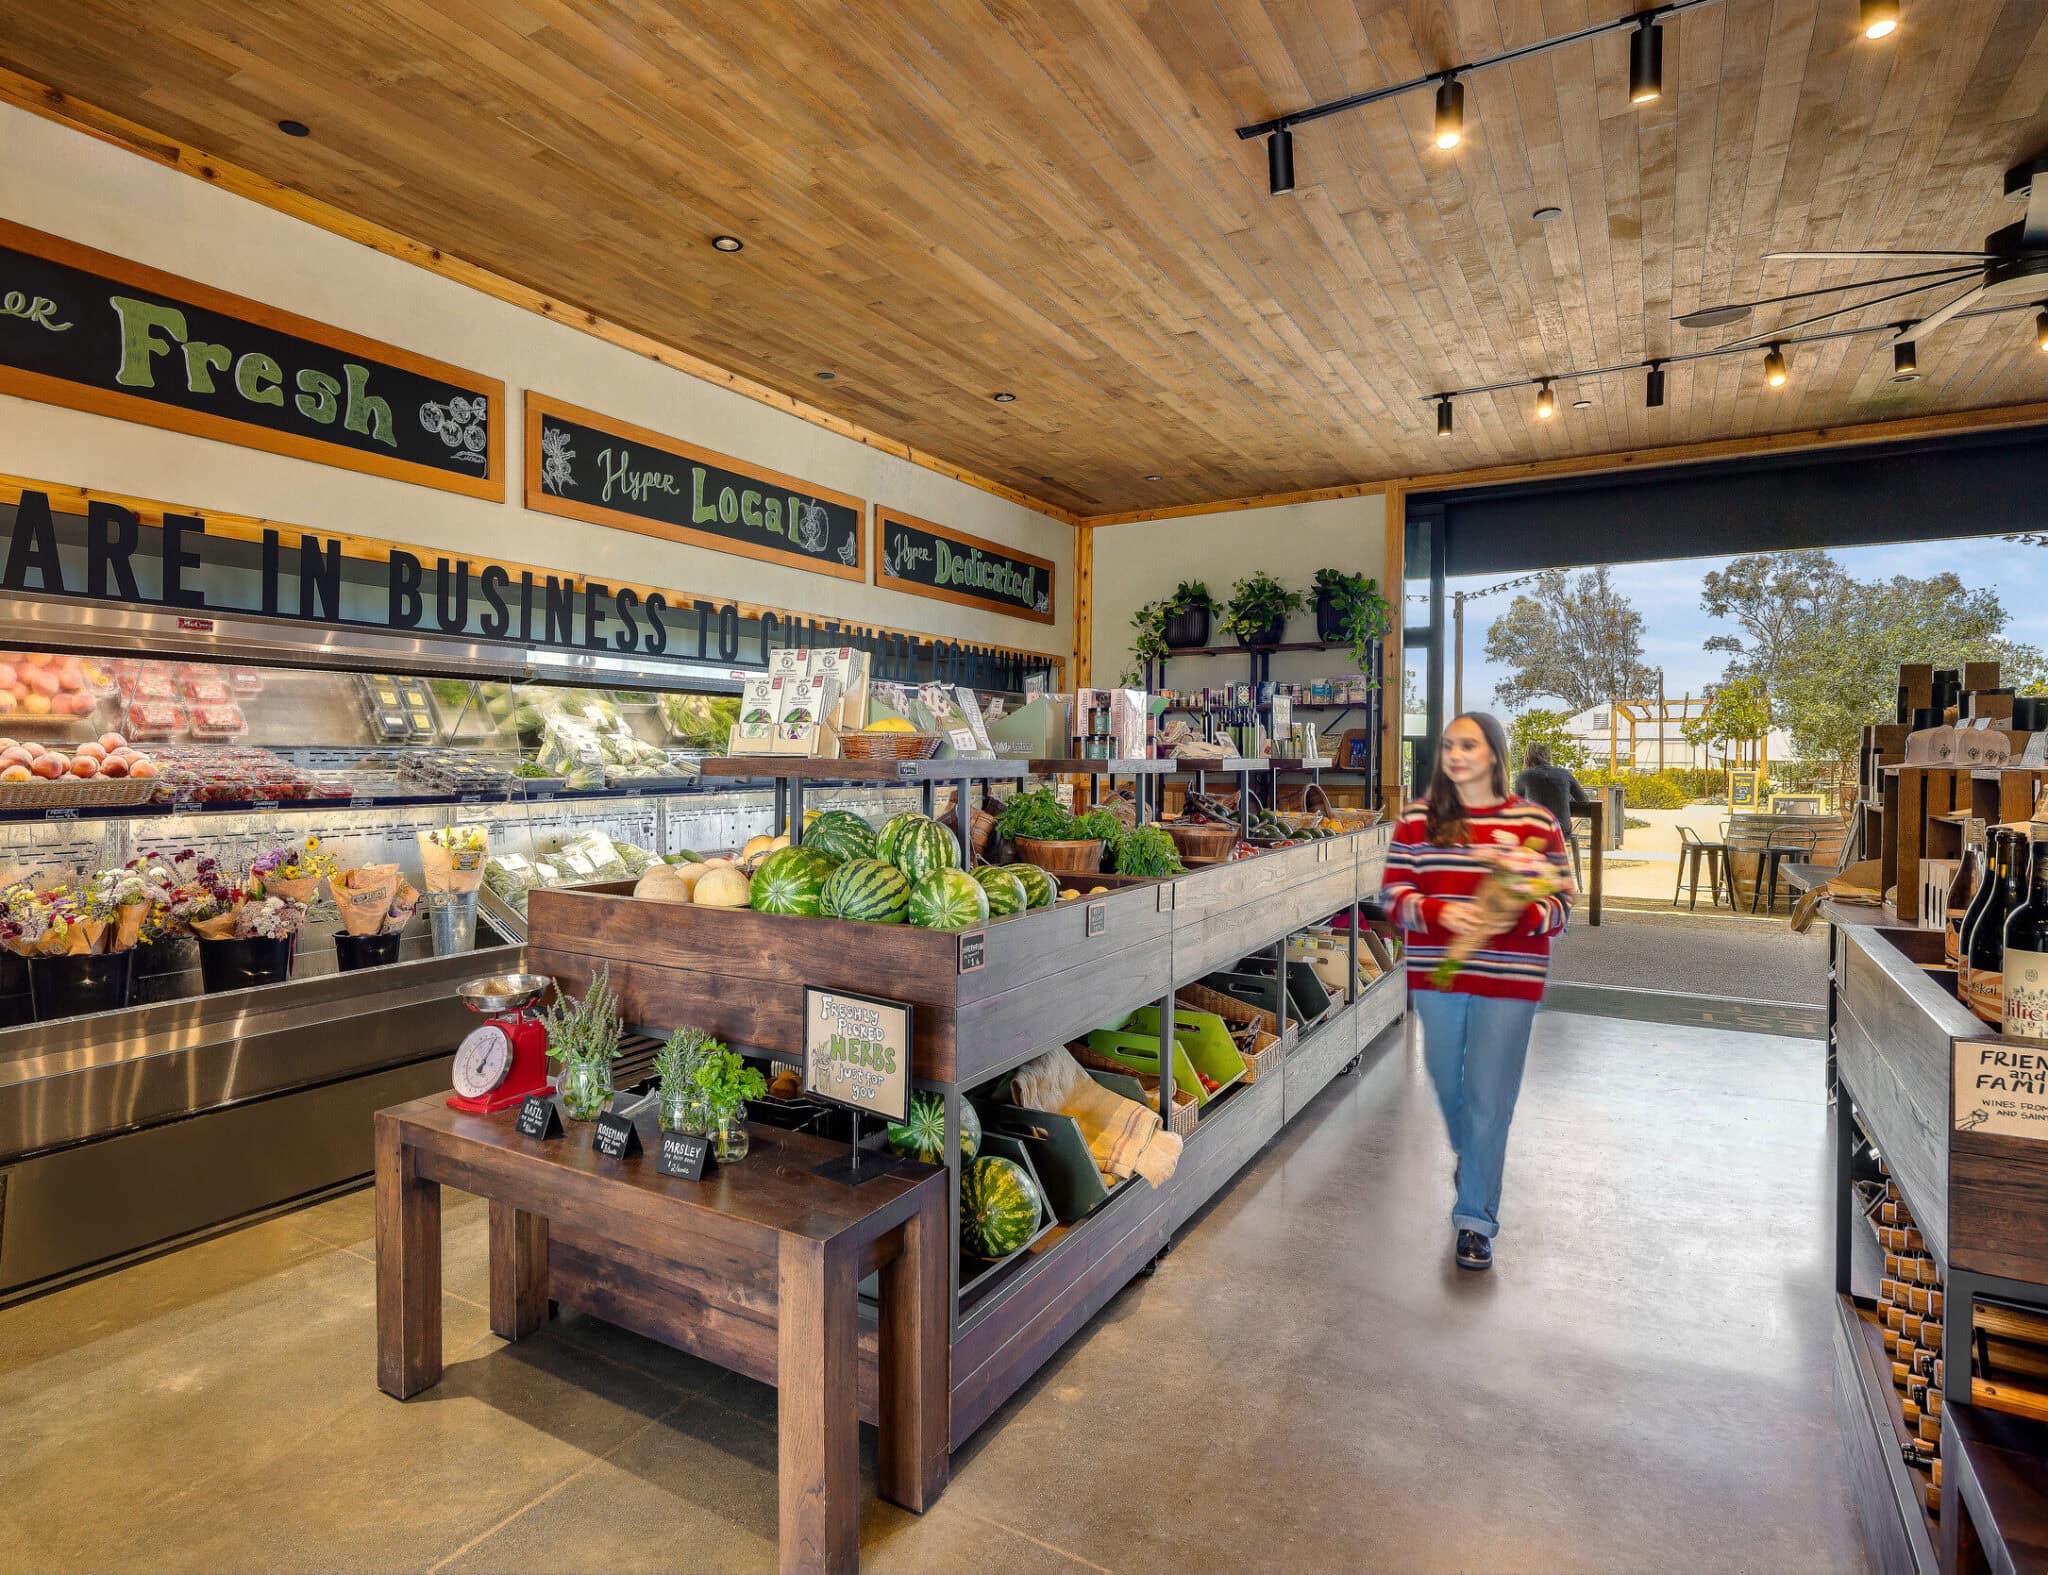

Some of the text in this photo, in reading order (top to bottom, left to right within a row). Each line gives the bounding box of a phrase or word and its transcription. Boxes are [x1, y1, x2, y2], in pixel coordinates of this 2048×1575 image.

[110, 295, 397, 447] Fresh
[597, 448, 800, 543] Hyper Local
[3, 489, 205, 602] ARE
[262, 529, 341, 619] IN
[389, 549, 667, 655] BUSINESS
[693, 600, 739, 662] TO
[894, 533, 1036, 607] Hyper Dedicated
[820, 995, 879, 1026] FRESHLY
[837, 1018, 885, 1042] PICKED
[830, 1034, 896, 1074] HERBS
[1980, 1050, 2048, 1070] FRIEN
[866, 1070, 884, 1087] for
[2009, 1070, 2046, 1082] and
[851, 1083, 876, 1101] you
[1982, 1099, 2016, 1109] WINES
[2021, 1112, 2048, 1121] SAIN
[664, 1140, 702, 1159] PARSLEY
